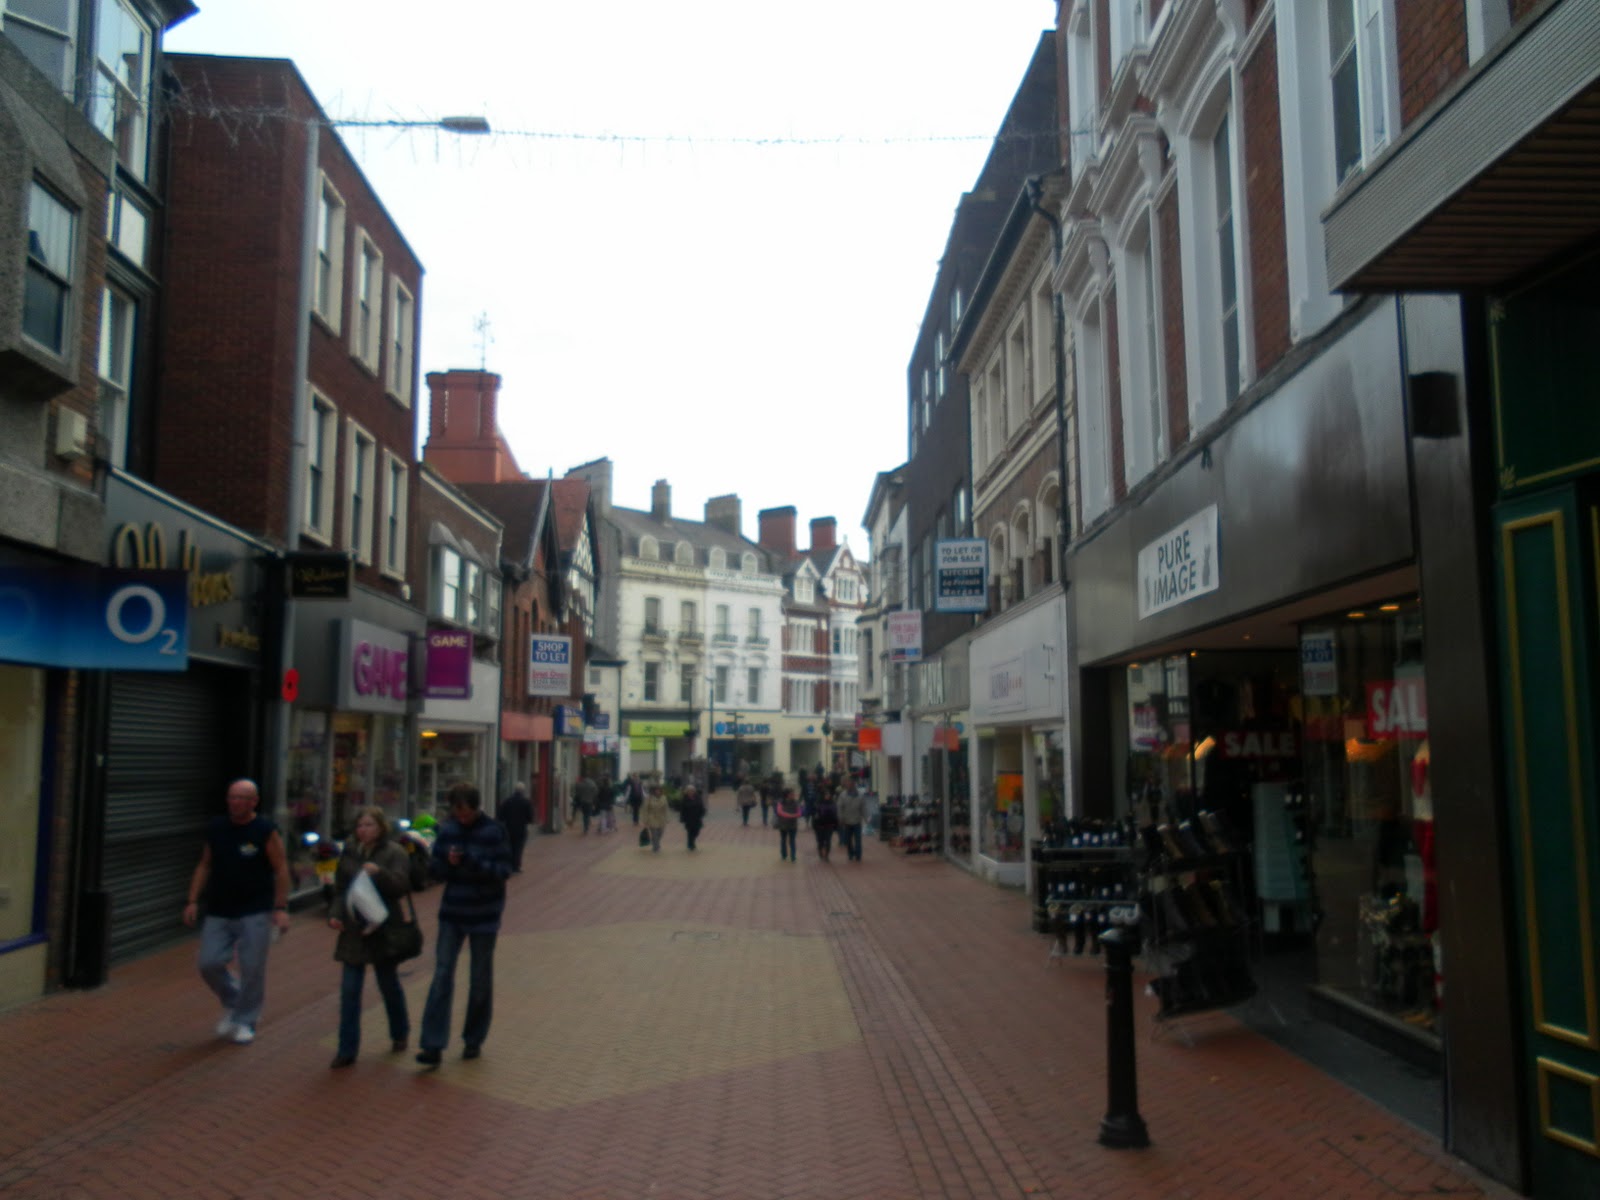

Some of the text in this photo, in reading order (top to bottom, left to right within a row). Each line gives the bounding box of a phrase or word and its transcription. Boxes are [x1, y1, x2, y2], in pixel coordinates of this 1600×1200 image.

[954, 547, 968, 555] LET
[1157, 530, 1191, 574] PURE
[960, 555, 980, 563] SALE
[942, 568, 980, 577] KITCHEN
[1154, 560, 1196, 606] IMAGE
[431, 635, 467, 648] GAME
[538, 641, 564, 652] SHOP
[535, 651, 566, 662] TO LET
[354, 640, 408, 699] GAME
[1224, 731, 1296, 757] SALE
